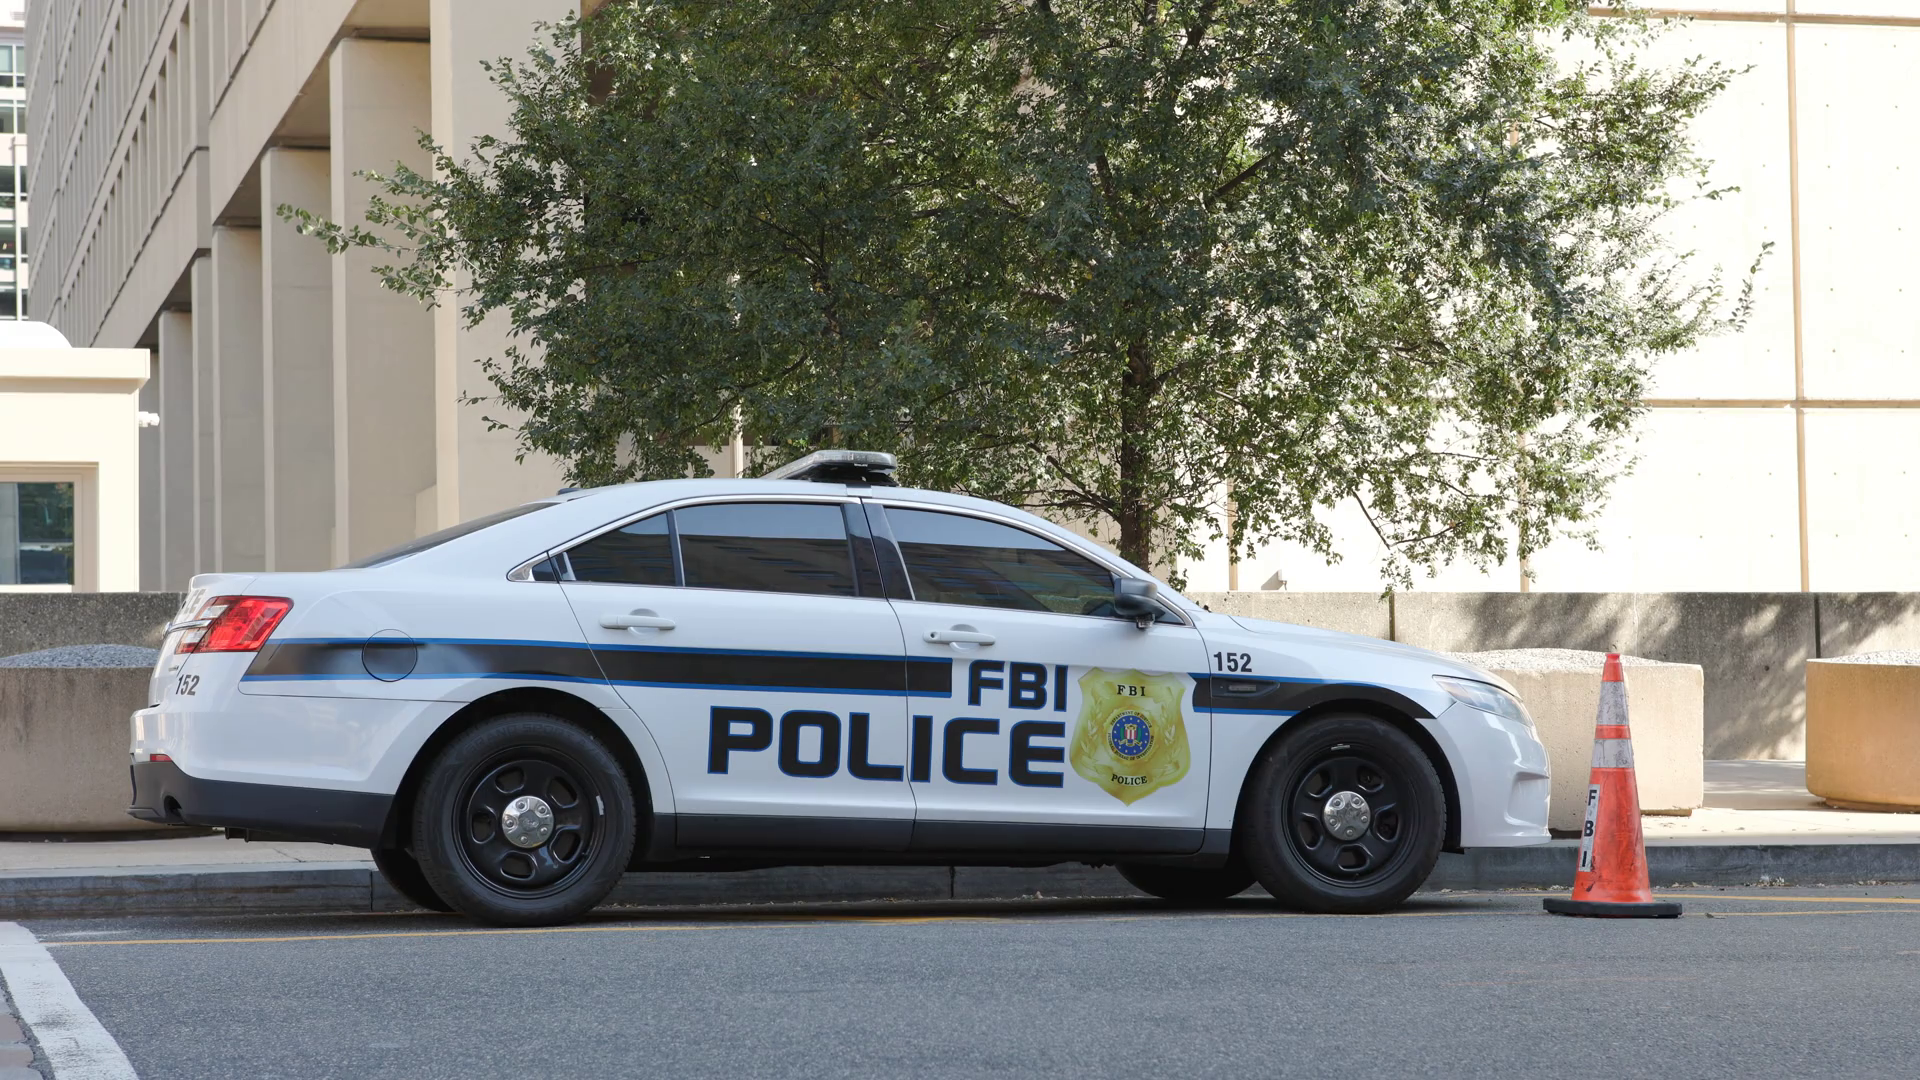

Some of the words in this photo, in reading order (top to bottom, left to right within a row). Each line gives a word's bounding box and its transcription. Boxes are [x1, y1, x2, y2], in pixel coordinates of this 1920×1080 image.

[1213, 652, 1252, 672] 152
[176, 675, 200, 696] 152
[968, 660, 1068, 712] FBI
[1117, 685, 1146, 697] FBI
[707, 705, 1065, 788] POLICE
[1111, 774, 1148, 785] POLICE
[1583, 790, 1597, 867] FBI
